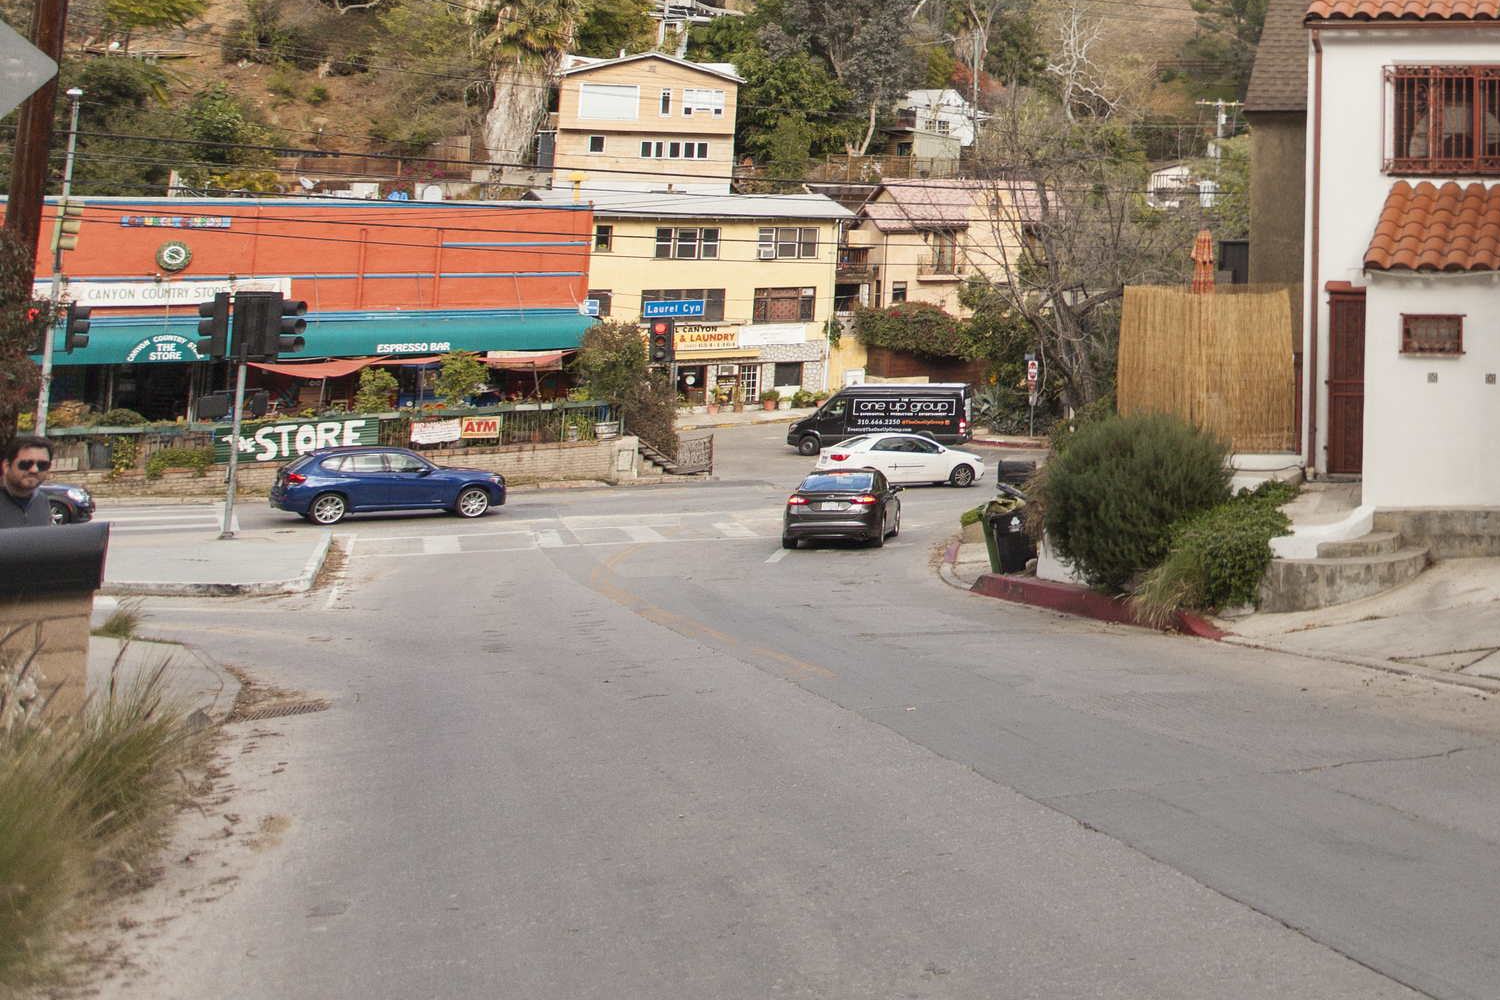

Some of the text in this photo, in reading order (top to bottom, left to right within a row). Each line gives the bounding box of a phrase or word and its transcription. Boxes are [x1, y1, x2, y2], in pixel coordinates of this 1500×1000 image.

[88, 289, 136, 300] CANYON
[142, 288, 190, 299] COUNTRY
[647, 303, 701, 314] Laurel Cyn
[679, 332, 736, 343] & LAUNDRY
[126, 339, 151, 362] CANYON
[152, 334, 188, 344] COUNTRY
[155, 343, 177, 352] THE
[376, 341, 451, 353] ESPRESSO BAR
[148, 351, 183, 361] STORE
[860, 402, 948, 413] one up group
[463, 421, 497, 432] ATM
[254, 419, 366, 462] STORE
